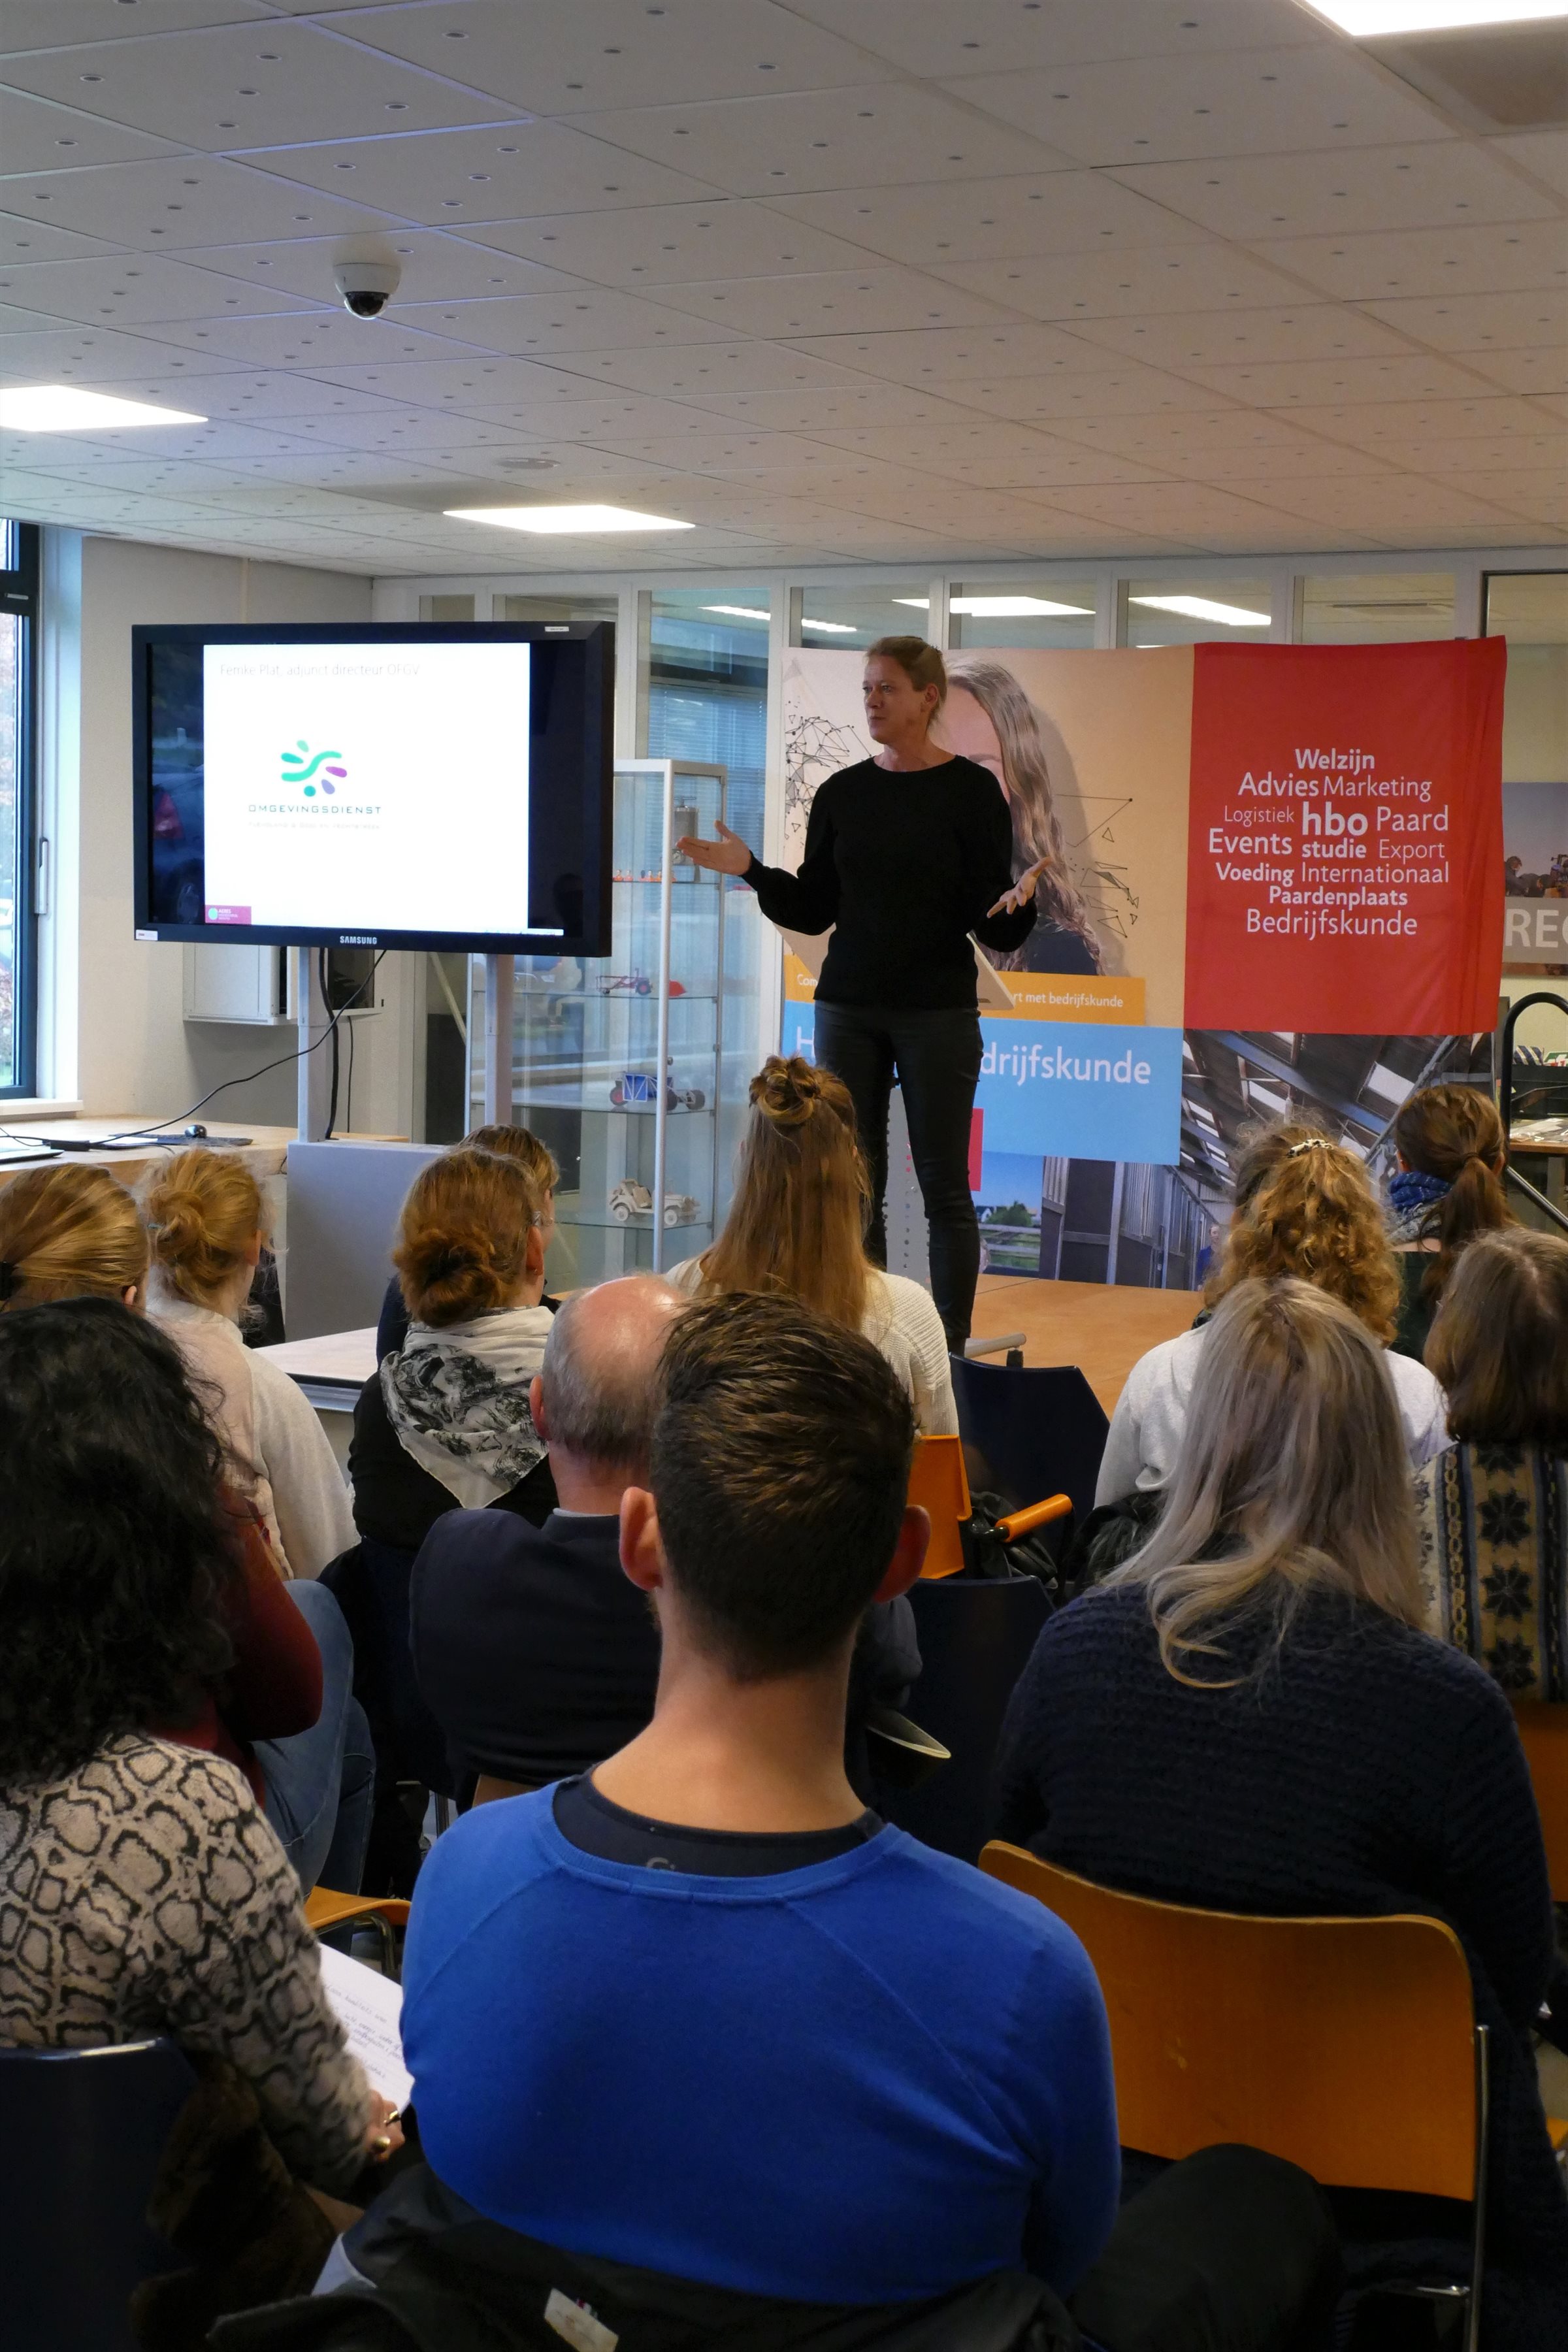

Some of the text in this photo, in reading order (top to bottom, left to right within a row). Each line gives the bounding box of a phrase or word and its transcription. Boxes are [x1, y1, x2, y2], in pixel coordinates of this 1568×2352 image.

[220, 664, 256, 676] Femke
[287, 664, 329, 678] adjunct
[332, 664, 384, 676] directeur
[387, 664, 420, 676] OFGV
[1295, 747, 1375, 776] Welzijn
[1237, 771, 1432, 802] Advies Marketing
[248, 804, 382, 814] OMGEVINGSDIENST
[1224, 801, 1448, 836] Logistiek hbo Paard
[1209, 828, 1445, 865] Events studie Export
[1215, 861, 1448, 888] Voeding Internationaal
[1269, 885, 1408, 911] Paardenplaats
[1247, 908, 1418, 941] Bedrijfskunde
[339, 936, 378, 945] SAMSUNG
[1026, 993, 1047, 1004] met
[1049, 992, 1124, 1009] bedrijfskunde
[980, 1041, 1152, 1087] drijfskunde
